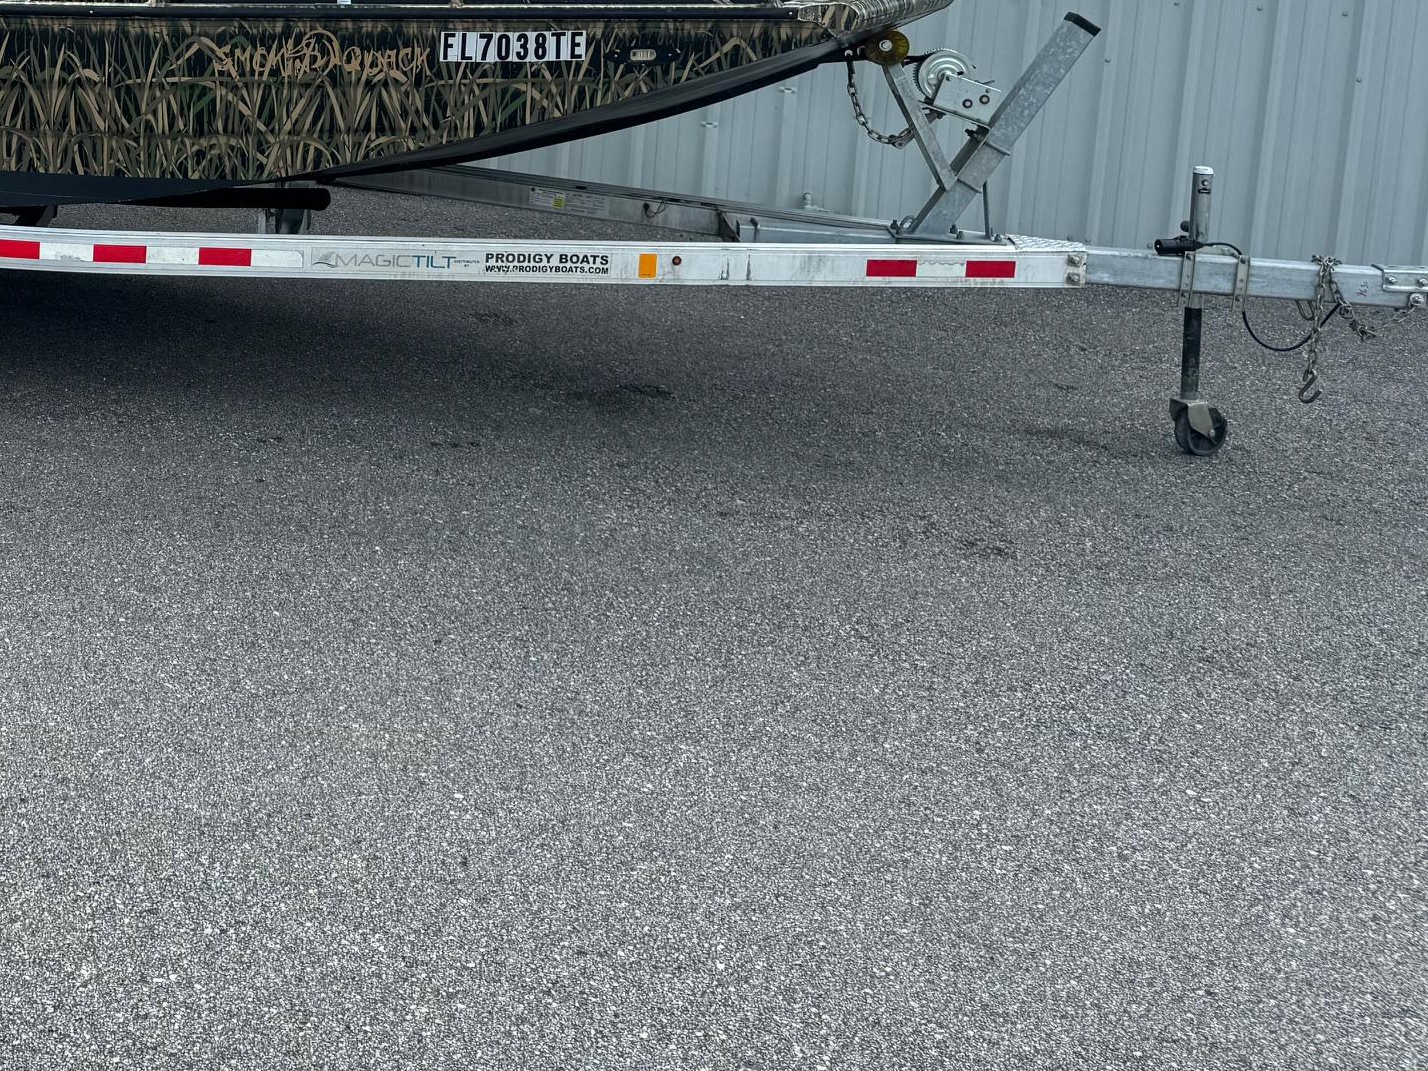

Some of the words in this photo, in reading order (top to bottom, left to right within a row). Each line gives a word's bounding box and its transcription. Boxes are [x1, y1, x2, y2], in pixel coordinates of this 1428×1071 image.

[442, 31, 585, 61] FL7038TE
[334, 253, 456, 269] MAGICTILT
[485, 253, 553, 264] PRODIGY
[558, 254, 609, 265] BOATS
